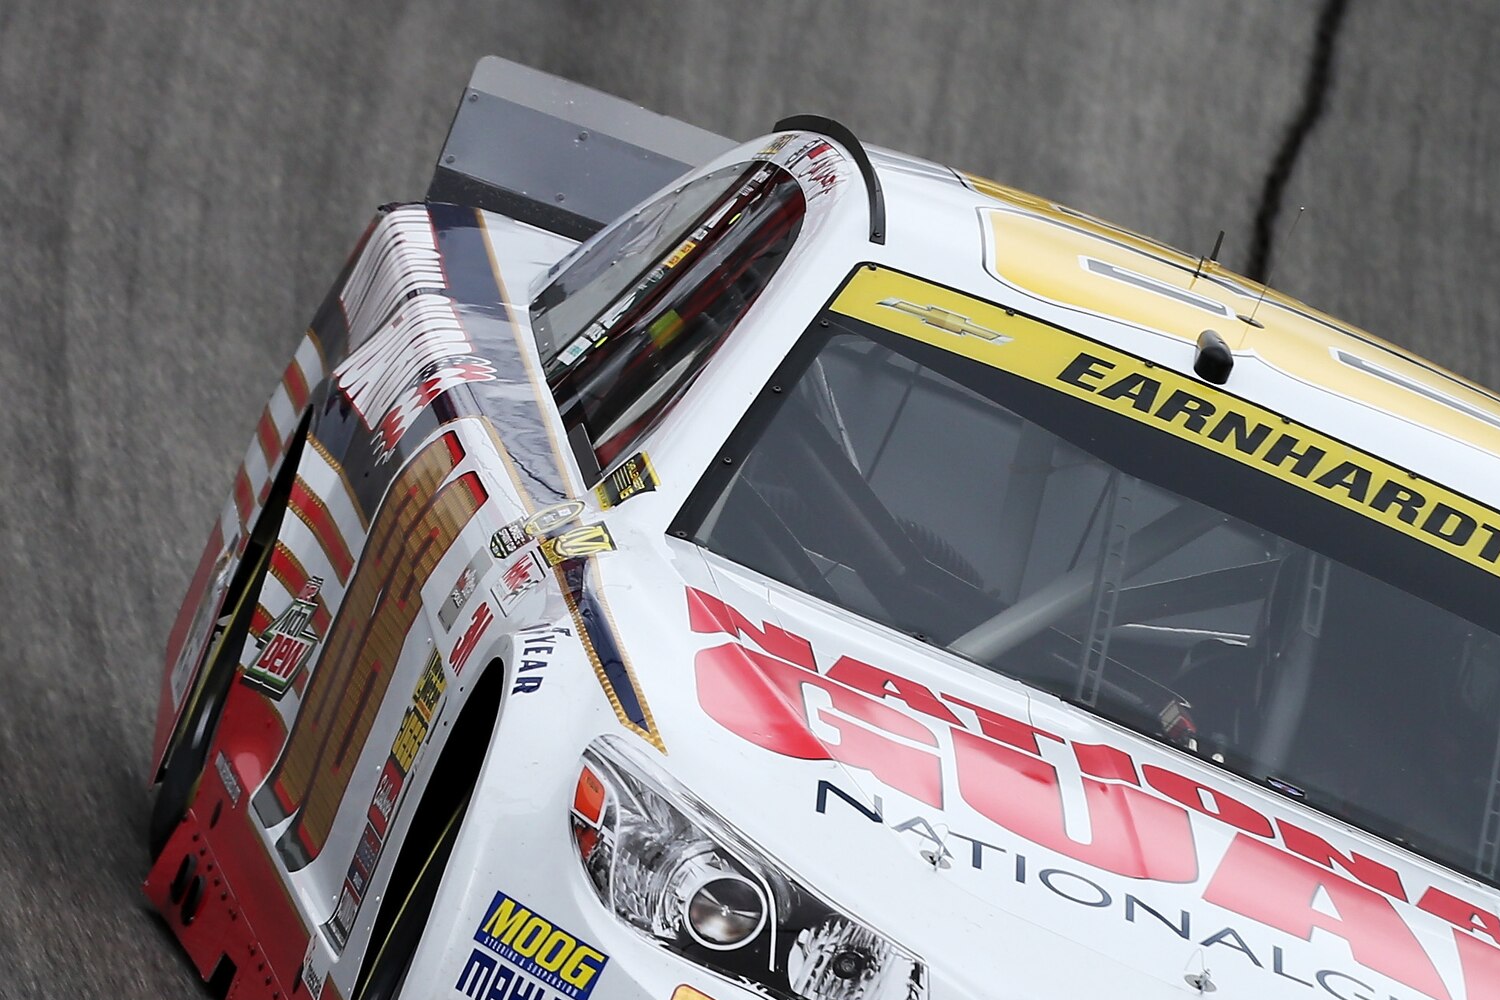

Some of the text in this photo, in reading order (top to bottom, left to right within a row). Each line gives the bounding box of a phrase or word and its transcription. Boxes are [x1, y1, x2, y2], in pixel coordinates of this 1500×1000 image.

[448, 601, 494, 677] 3M
[482, 898, 605, 991] MOOG
[483, 935, 518, 963] STEERING
[526, 961, 578, 998] SUSPENSION
